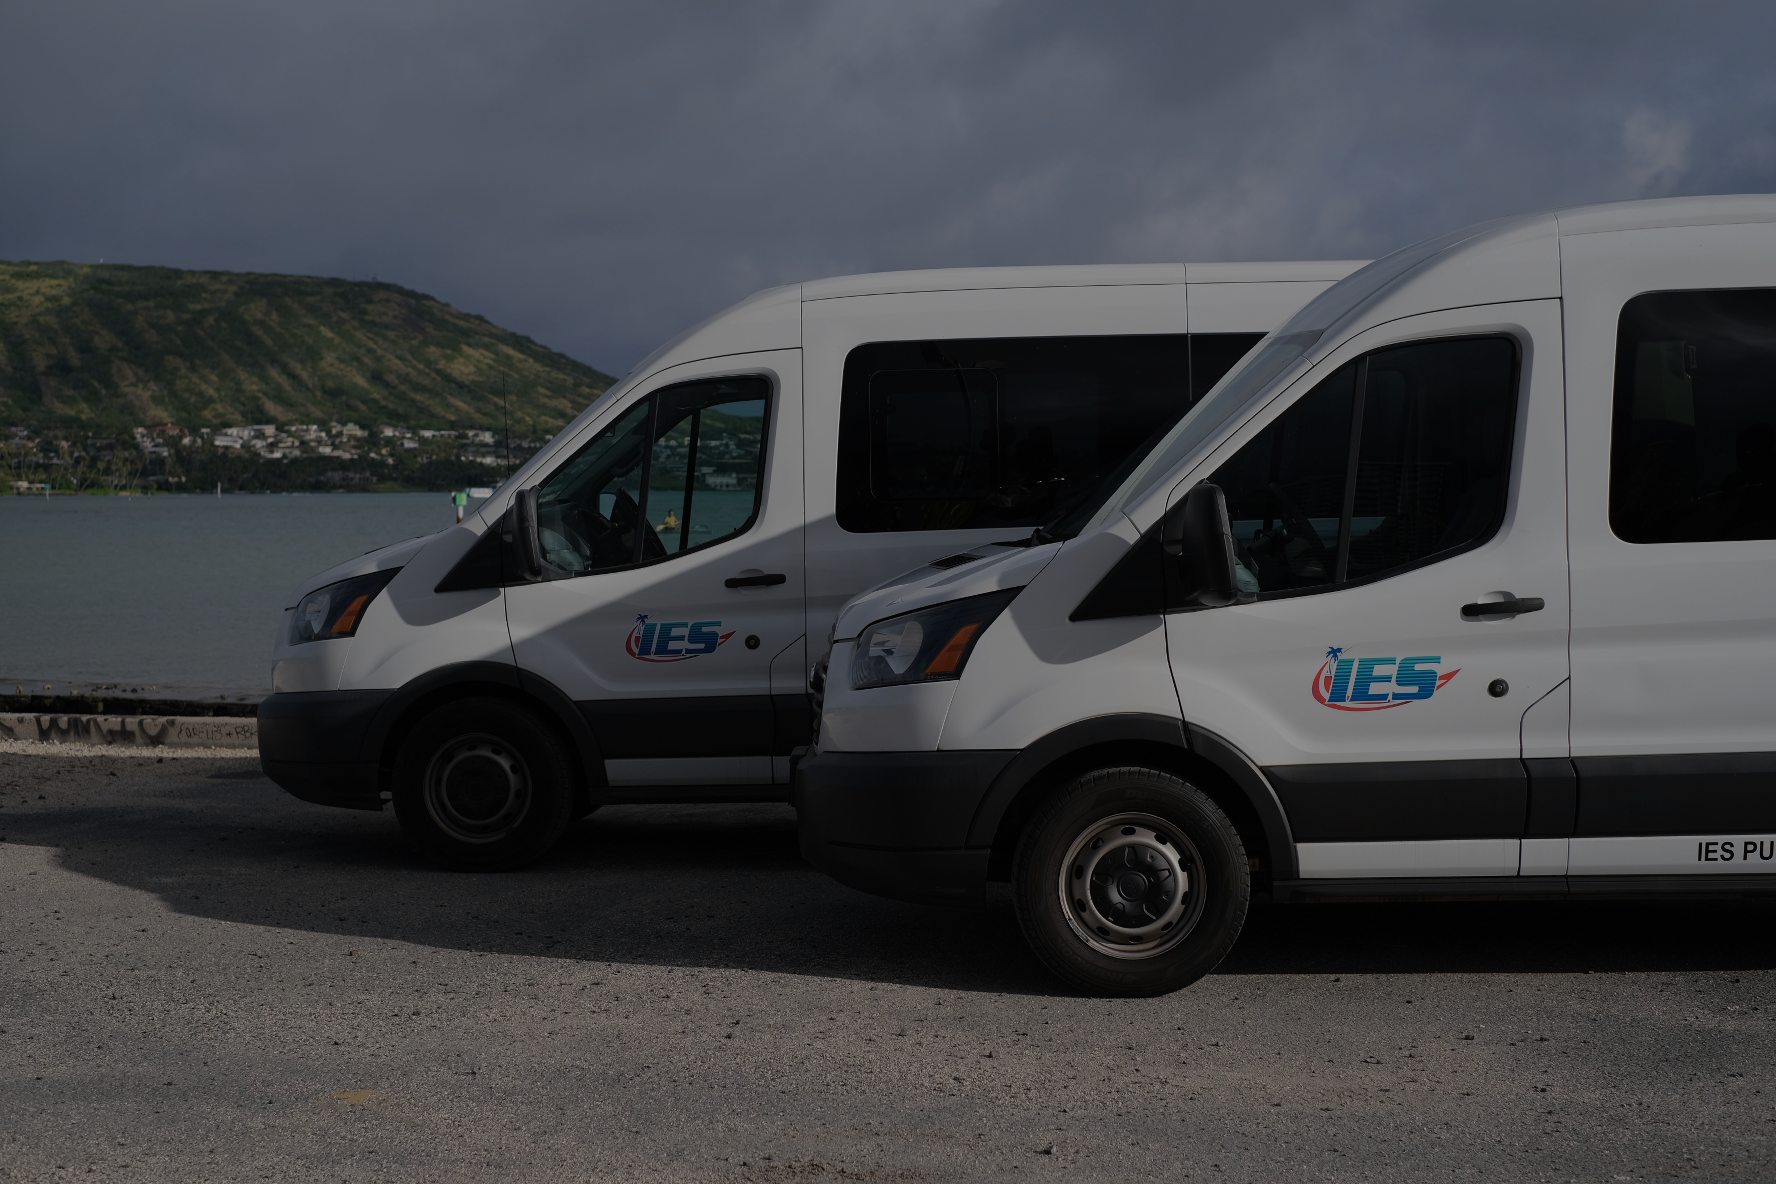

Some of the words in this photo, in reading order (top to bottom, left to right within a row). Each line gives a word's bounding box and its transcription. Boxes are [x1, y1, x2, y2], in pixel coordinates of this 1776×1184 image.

[637, 620, 723, 656] IES
[1327, 655, 1442, 703] IES
[1697, 841, 1735, 862] IES
[1742, 840, 1775, 861] PU
